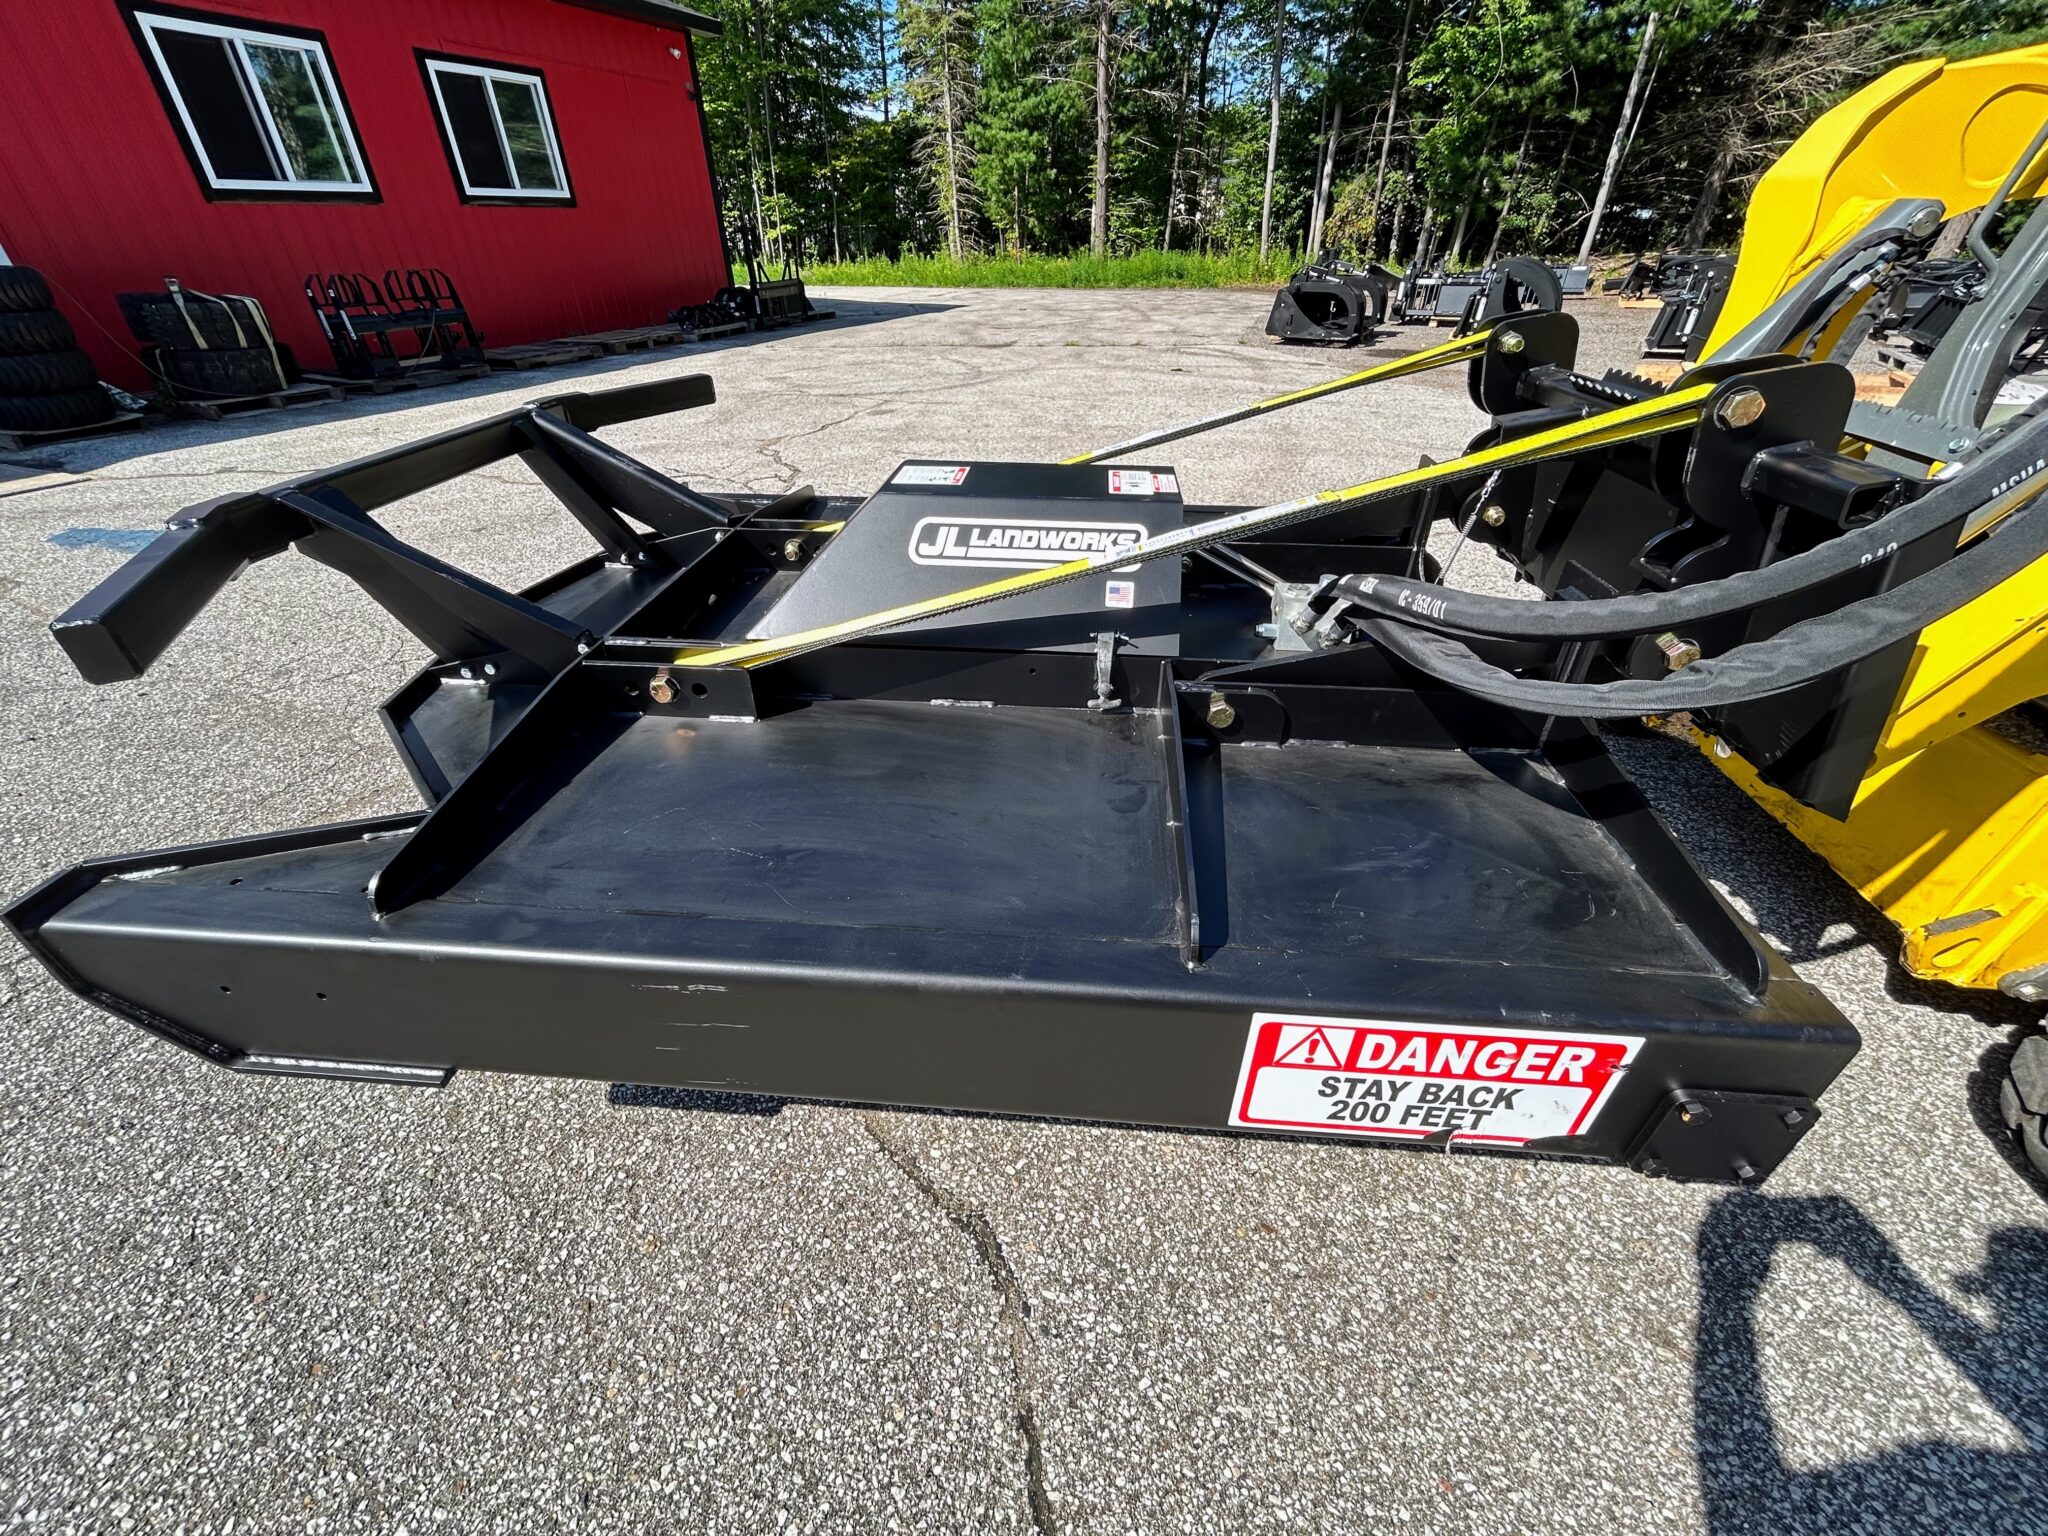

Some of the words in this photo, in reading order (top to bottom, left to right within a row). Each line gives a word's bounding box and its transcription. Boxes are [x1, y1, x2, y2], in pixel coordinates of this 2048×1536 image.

[919, 526, 967, 557] JL
[969, 528, 1138, 551] LANDWORKS
[1355, 1034, 1597, 1083] DANGER
[1317, 1076, 1413, 1101] STAY
[1418, 1082, 1525, 1111] BACK
[1327, 1100, 1391, 1124] 200
[1400, 1104, 1493, 1131] FEET
